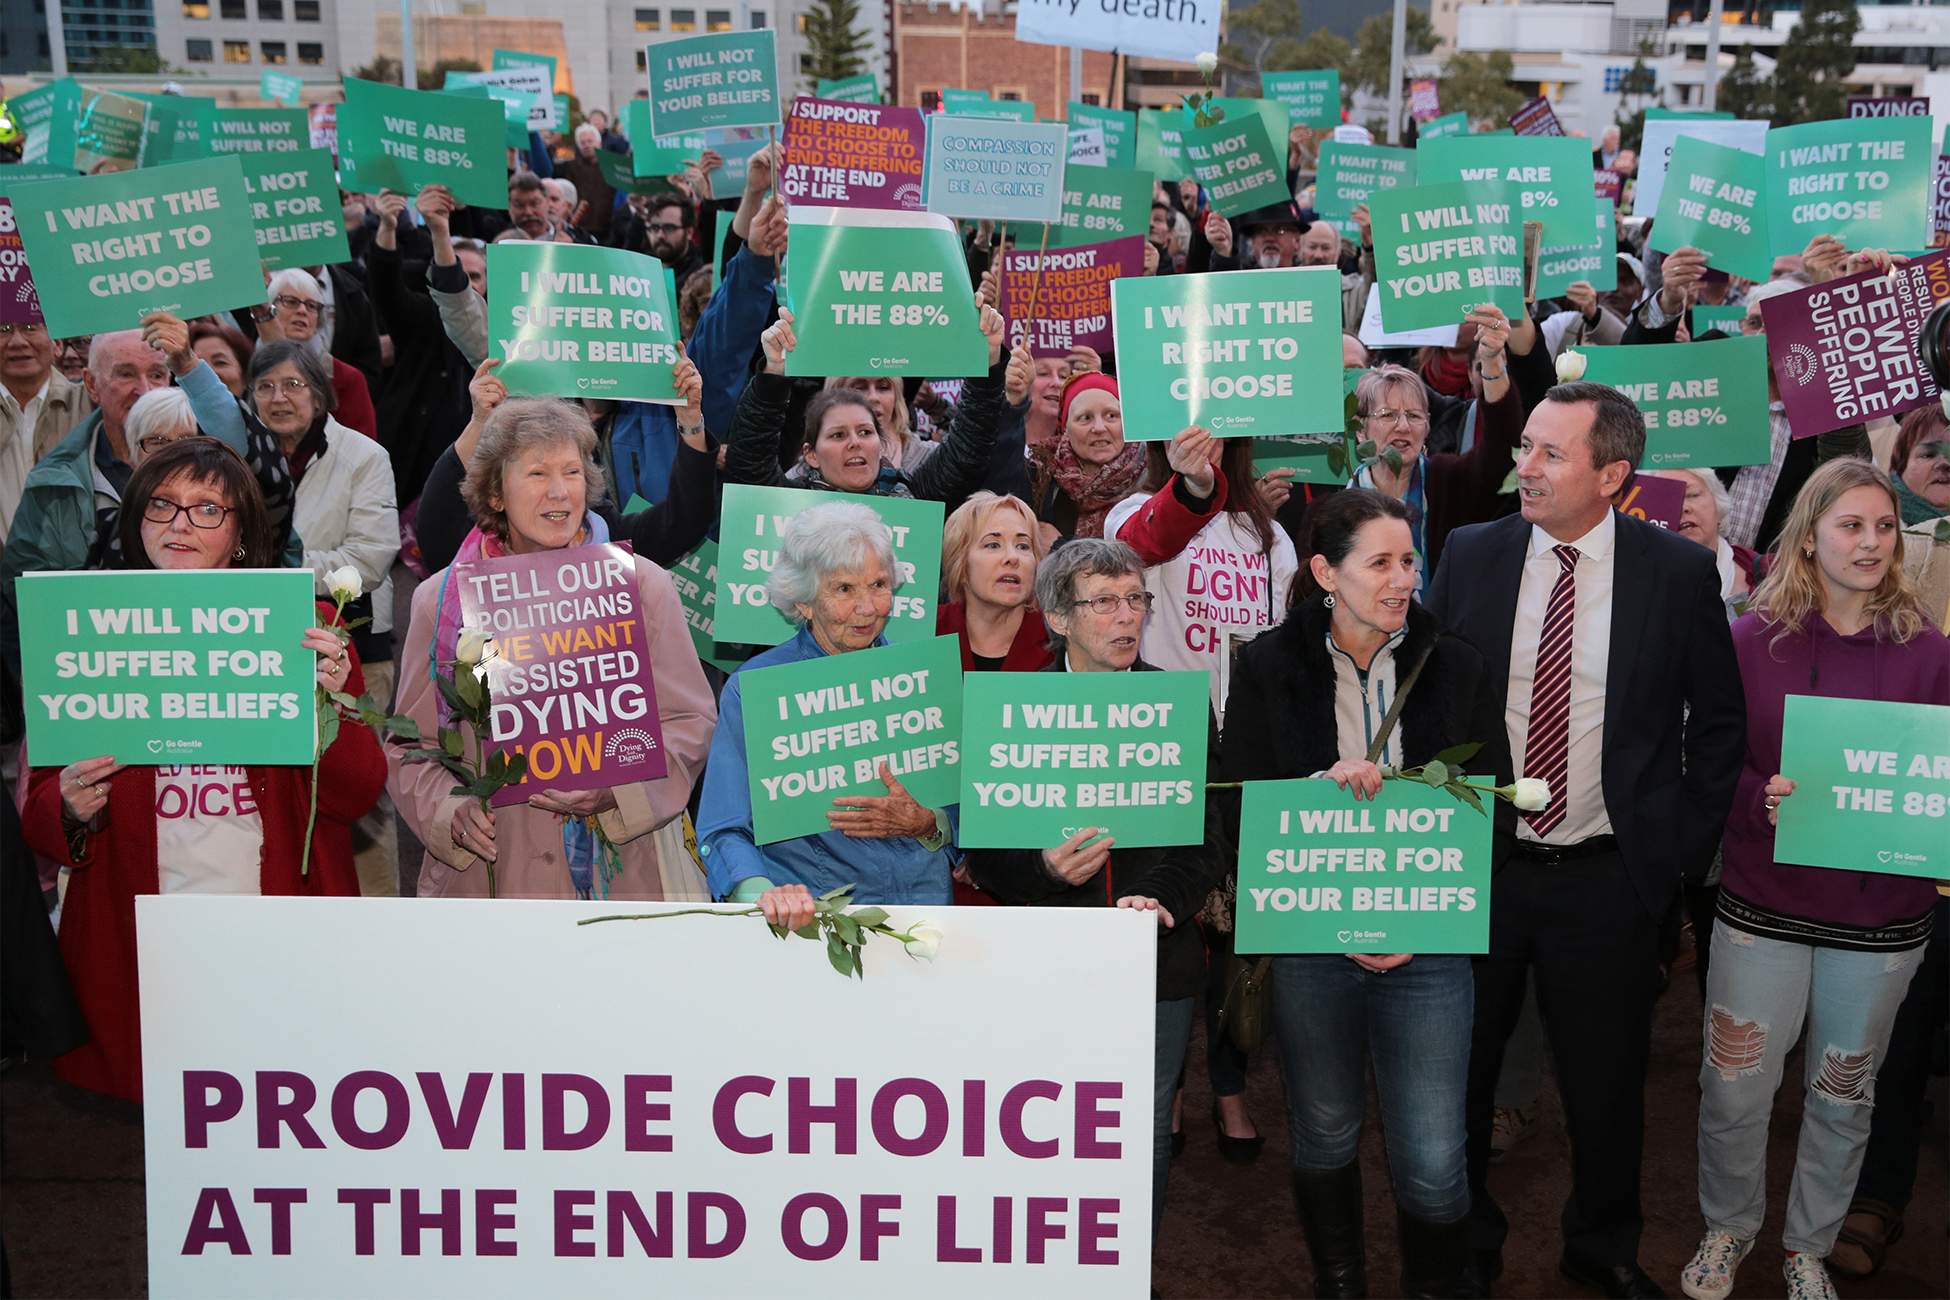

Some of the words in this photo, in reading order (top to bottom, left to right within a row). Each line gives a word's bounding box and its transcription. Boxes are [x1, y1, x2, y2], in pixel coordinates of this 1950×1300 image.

[676, 52, 714, 69] WILL
[719, 48, 754, 64] NOT
[664, 70, 723, 92] SUFFER
[727, 68, 762, 84] FOR
[1276, 81, 1308, 91] WANT
[1312, 80, 1329, 90] THE
[658, 93, 703, 114] YOUR
[707, 88, 771, 106] BELIEFS
[1309, 94, 1324, 104] TO
[1851, 102, 1927, 118] DYING
[800, 102, 881, 126] SUPPORT
[259, 122, 291, 134] NOT
[383, 115, 417, 138] WE
[423, 124, 466, 144] ARE
[790, 117, 823, 136] THE
[826, 121, 909, 143] FREEDOM
[211, 139, 264, 152] SUFFER
[267, 139, 298, 151] FOR
[380, 138, 419, 161] THE
[424, 148, 472, 169] 88%
[655, 137, 680, 149] THE
[788, 133, 812, 148] TO
[815, 136, 887, 157] CHOOSE
[891, 143, 916, 158] TO
[943, 136, 1055, 156] COMPASSION
[1212, 134, 1248, 156] NOT
[1790, 144, 1852, 167] WANT
[1858, 141, 1906, 160] THE
[786, 150, 824, 166] END
[826, 152, 922, 174] SUFFERING
[944, 158, 1010, 176] SHOULD
[1016, 161, 1051, 178] NOT
[1226, 152, 1262, 174] FOR
[1338, 155, 1378, 169] WANT
[1382, 158, 1406, 172] THE
[1505, 166, 1552, 182] ARE
[260, 171, 308, 192] NOT
[784, 164, 816, 180] AT
[818, 166, 846, 184] THE
[848, 169, 886, 187] END
[948, 180, 968, 194] BE
[992, 181, 1044, 197] CRIME
[1214, 169, 1277, 200] BELIEFS
[1336, 170, 1376, 186] RIGHT
[1378, 173, 1398, 188] TO
[1788, 173, 1848, 196] RIGHT
[1854, 171, 1890, 190] TO
[784, 180, 808, 197] OF
[811, 182, 850, 200] LIFE.
[1086, 194, 1122, 210] ARE
[1689, 174, 1716, 196] WE
[1716, 183, 1756, 208] ARE
[61, 197, 155, 230] WANT
[162, 187, 220, 215] THE
[274, 196, 323, 218] FOR
[1415, 206, 1473, 230] WILL
[1476, 204, 1510, 224] NOT
[1678, 198, 1706, 220] THE
[1708, 208, 1751, 234] 88%
[1792, 201, 1882, 224] CHOOSE
[255, 220, 336, 245] BELIEFS
[1084, 215, 1124, 232] 88%
[71, 232, 162, 264] RIGHT
[169, 224, 212, 249] TO
[1396, 237, 1484, 266] SUFFER
[1489, 236, 1517, 256] FOR
[1015, 250, 1097, 271] SUPPORT
[1543, 256, 1602, 276] CHOOSE
[88, 258, 214, 297] CHOOSE
[537, 272, 603, 294] WILL
[609, 274, 650, 298] NOT
[839, 271, 884, 292] WE
[891, 271, 944, 292] ARE
[1045, 262, 1122, 286] FREEDOM
[1386, 273, 1462, 298] YOUR
[1468, 266, 1522, 288] BELIEFS
[1008, 288, 1033, 302] TO
[1038, 283, 1106, 303] CHOOSE
[511, 306, 614, 328] SUFFER
[620, 308, 664, 332] FOR
[831, 304, 882, 326] THE
[889, 304, 950, 326] 88%
[1037, 319, 1071, 334] THE
[1074, 315, 1106, 334] END
[1161, 303, 1251, 328] WANT
[1258, 300, 1313, 324] THE
[1039, 334, 1072, 350] LIFE
[1862, 276, 1920, 406] FEWER
[1896, 270, 1916, 318] PEOPLE
[1924, 384, 1938, 398] IN
[498, 340, 580, 361] YOUR
[588, 341, 676, 364] BELIEFS
[1162, 339, 1250, 364] RIGHT
[1258, 337, 1299, 360] TO
[1808, 292, 1858, 420] SUFFERING
[1832, 283, 1888, 415] PEOPLE
[1170, 374, 1293, 400] CHOOSE
[1666, 378, 1719, 398] ARE
[1666, 407, 1728, 427] 88%
[469, 569, 550, 604] TELL
[557, 558, 628, 592] OUR
[1187, 563, 1268, 607] DIGNIT
[66, 610, 78, 635] I
[88, 608, 181, 634] WILL
[192, 607, 270, 634] NOT
[477, 592, 632, 631] POLITICIANS
[1185, 600, 1250, 624] SHOULD
[491, 635, 533, 662] WE
[541, 620, 636, 656] WANT
[54, 650, 198, 678] SUFFER
[208, 650, 284, 676] FOR
[490, 650, 640, 697] ASSISTED
[38, 694, 150, 720] YOUR
[160, 692, 300, 720] BELIEFS
[794, 686, 865, 716] WILL
[870, 670, 930, 702] NOT
[492, 684, 648, 742] DYING
[1022, 704, 1098, 729] WILL
[1107, 702, 1172, 728] NOT
[771, 718, 878, 760] SUFFER
[886, 706, 944, 738] FOR
[502, 732, 602, 788] NOW
[619, 744, 642, 752] Dying
[989, 743, 1109, 769] SUFFER
[1118, 742, 1181, 768] FOR
[760, 764, 846, 801] YOUR
[854, 741, 960, 784] BELIEFS
[1844, 749, 1898, 775] WE
[1906, 754, 1950, 779] AR
[157, 782, 258, 819] OICE
[972, 782, 1066, 808] YOUR
[1076, 780, 1194, 808] BELIEFS
[1832, 786, 1893, 813] THE
[1299, 809, 1375, 834] WILL
[1385, 808, 1454, 832] NOT
[1266, 848, 1386, 873] SUFFER
[1396, 848, 1463, 872] FOR
[1248, 888, 1342, 912] YOUR
[1352, 887, 1476, 912] BELIEFS
[182, 1070, 673, 1153] PROVIDE
[712, 1074, 1122, 1159] CHOICE
[180, 1187, 308, 1256] AT
[337, 1187, 517, 1257] THE
[554, 1189, 747, 1260] END
[780, 1192, 902, 1263] OF
[936, 1195, 1120, 1266] LIFE
